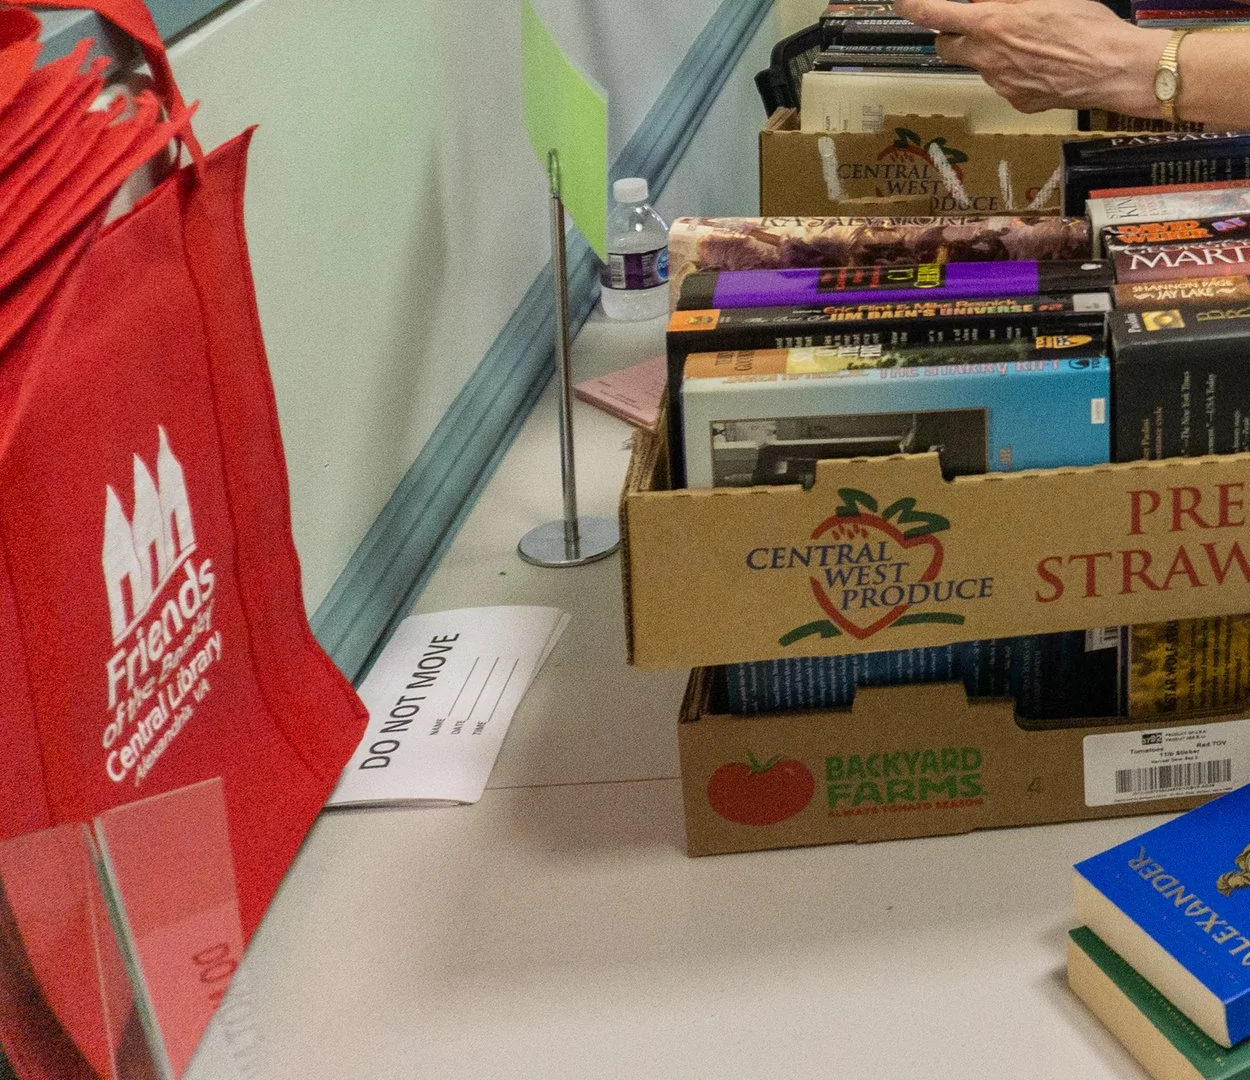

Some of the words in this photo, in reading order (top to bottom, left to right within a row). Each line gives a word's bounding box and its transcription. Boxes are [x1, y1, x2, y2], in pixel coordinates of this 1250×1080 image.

[836, 163, 932, 181] CENTRAL
[887, 180, 943, 197] WEST
[1117, 197, 1140, 219] KIN
[1118, 220, 1200, 234] DAVID
[1119, 228, 1214, 245] WEBER
[1132, 281, 1199, 293] SHANNON
[1202, 279, 1235, 288] PAGE
[1157, 289, 1179, 301] JAY
[1181, 287, 1215, 299] LAKE
[823, 305, 855, 315] Eric
[858, 303, 893, 313] Flint
[896, 303, 911, 311] &
[914, 301, 952, 310] Mike
[955, 299, 1018, 308] Resnick
[829, 312, 864, 322] JIM
[867, 309, 937, 320] BAEN'S
[939, 304, 1034, 317] UNIVERSE
[1182, 370, 1191, 390] Times
[746, 540, 893, 571] CENTRAL
[824, 561, 910, 589] WEST
[840, 576, 993, 611] PRODUCE
[106, 558, 215, 710] Friends
[405, 633, 460, 690] MOVE
[193, 679, 211, 703] VA
[102, 701, 125, 750] of
[127, 676, 156, 723] the
[106, 691, 169, 783] Central
[166, 631, 222, 710] Library
[379, 695, 427, 734] NOT
[1130, 746, 1165, 755] Tomatoes
[1212, 739, 1228, 747] TOV
[358, 739, 401, 771] DO
[825, 747, 983, 781] BACKYARD
[827, 773, 985, 808] FARMS
